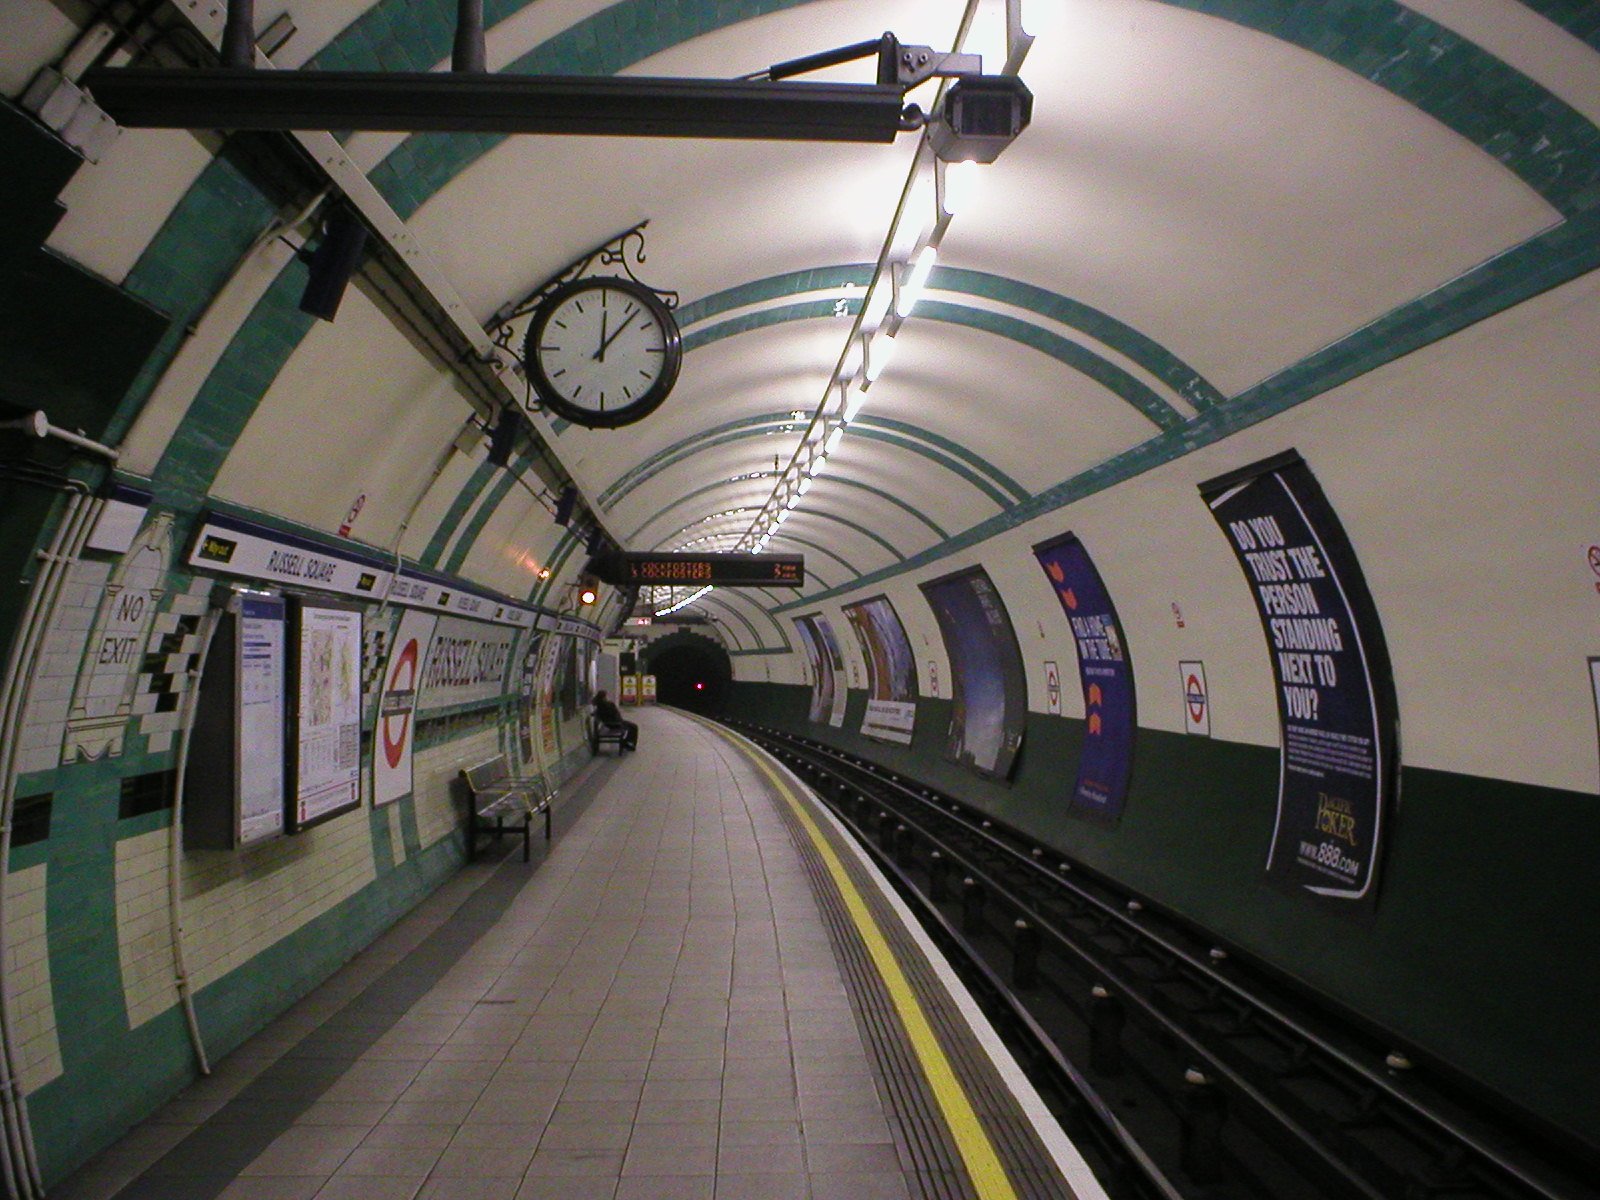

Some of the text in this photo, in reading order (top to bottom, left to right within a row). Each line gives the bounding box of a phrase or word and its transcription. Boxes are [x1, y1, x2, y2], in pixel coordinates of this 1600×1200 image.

[1229, 515, 1285, 550] DO YOU
[266, 550, 305, 577] RUSSELL
[303, 558, 337, 583] SQUARE
[641, 562, 712, 571] COCKFOSTERS
[641, 569, 712, 579] COCKFOSTERS
[1244, 545, 1326, 582] TRUST THE
[117, 594, 144, 622] NO
[1259, 583, 1320, 615] PERSON
[99, 637, 137, 664] EXIT
[1270, 618, 1343, 652] STANDING
[1278, 652, 1337, 688] NEXT TO
[1282, 685, 1319, 721] YOU?
